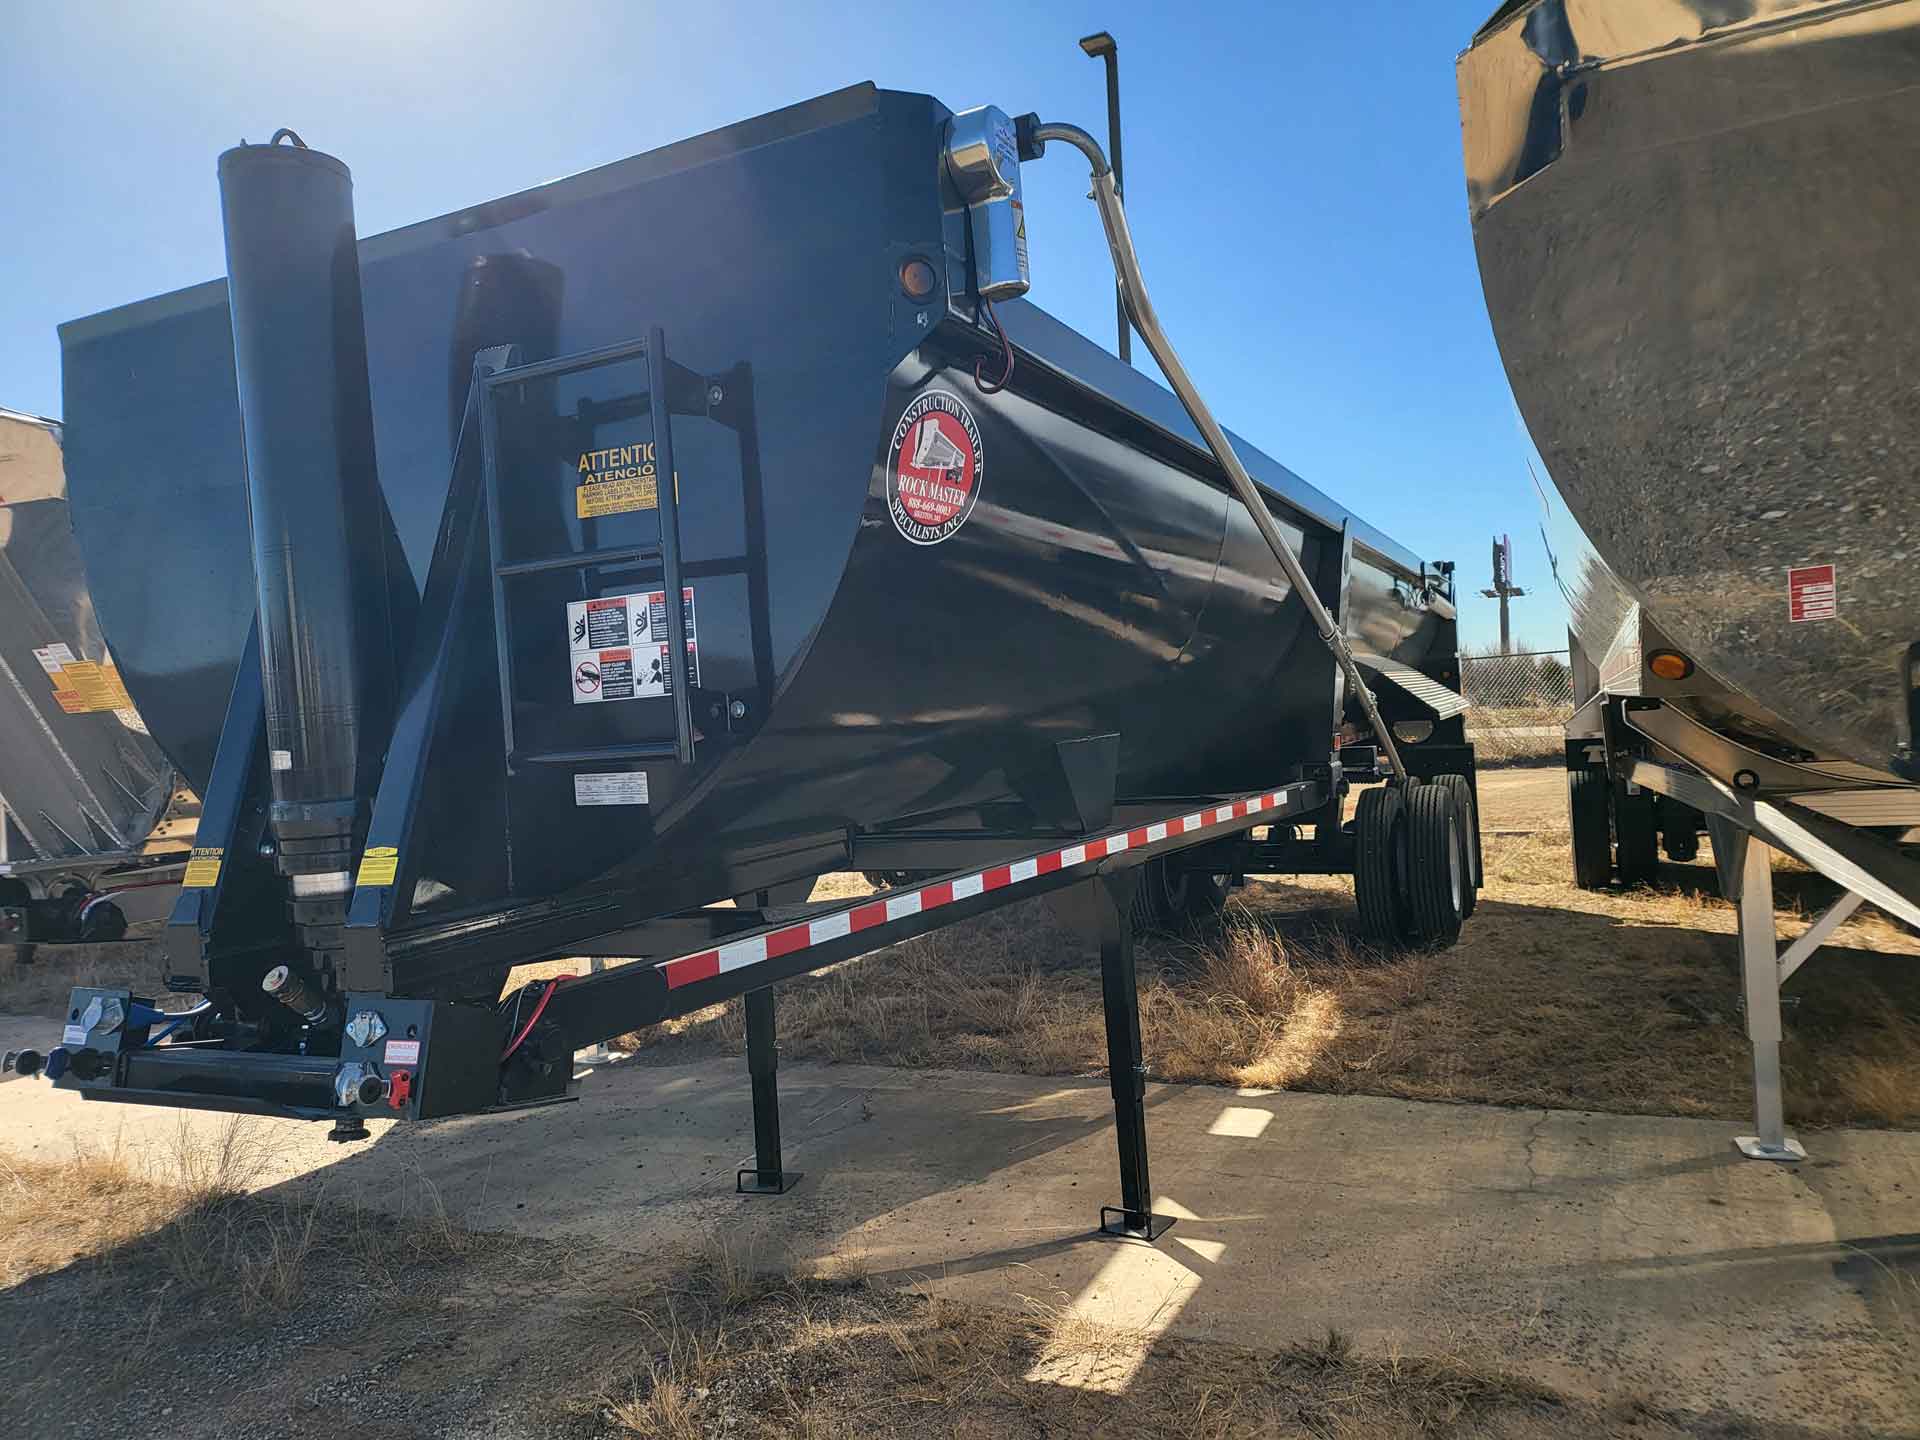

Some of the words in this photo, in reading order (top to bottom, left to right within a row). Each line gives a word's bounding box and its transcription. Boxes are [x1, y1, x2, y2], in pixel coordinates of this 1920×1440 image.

[895, 396, 960, 450] CONSTRUCTION
[960, 410, 980, 475] TRAILER
[578, 442, 655, 473] ATTENTIO
[585, 462, 655, 484] ATENCIÓ
[898, 474, 930, 497] ROCK
[928, 482, 966, 507] MASTER
[943, 513, 963, 533] INC.
